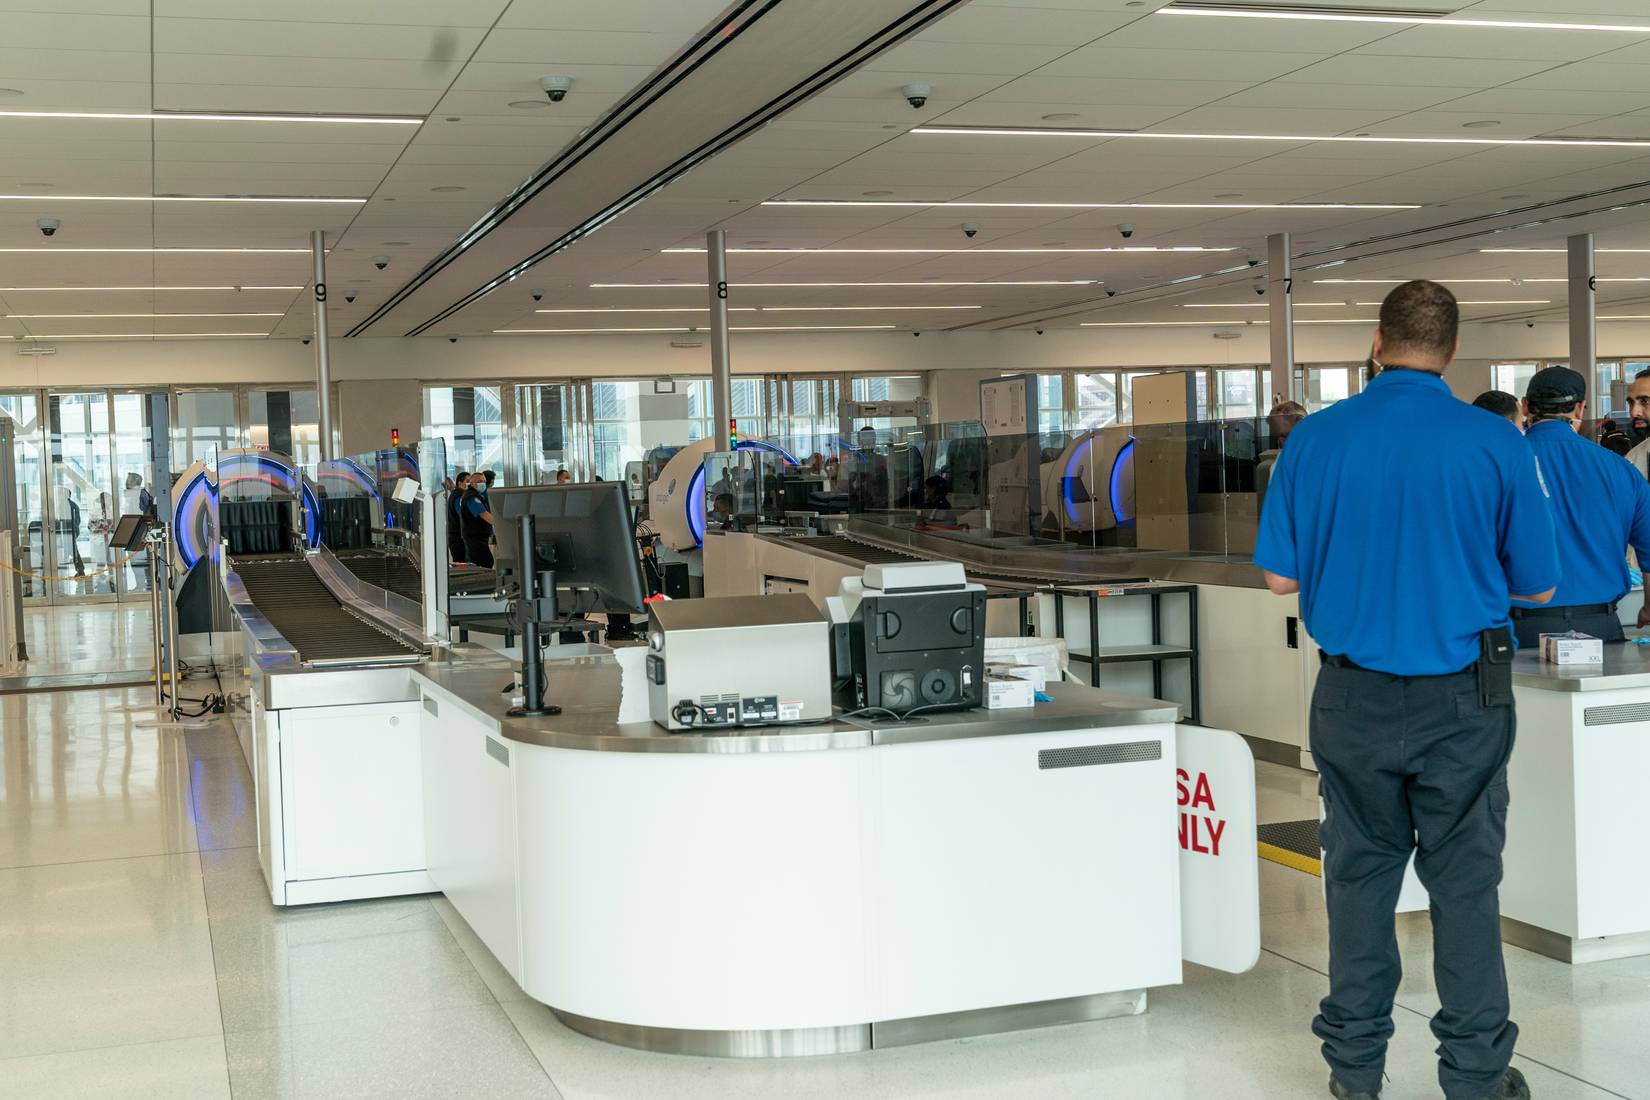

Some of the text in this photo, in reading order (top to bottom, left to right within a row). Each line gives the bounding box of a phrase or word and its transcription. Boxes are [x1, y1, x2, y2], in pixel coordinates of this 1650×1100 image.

[314, 283, 327, 302] 9
[717, 281, 728, 299] 8
[1283, 278, 1292, 294] 7
[1176, 768, 1216, 811] SA
